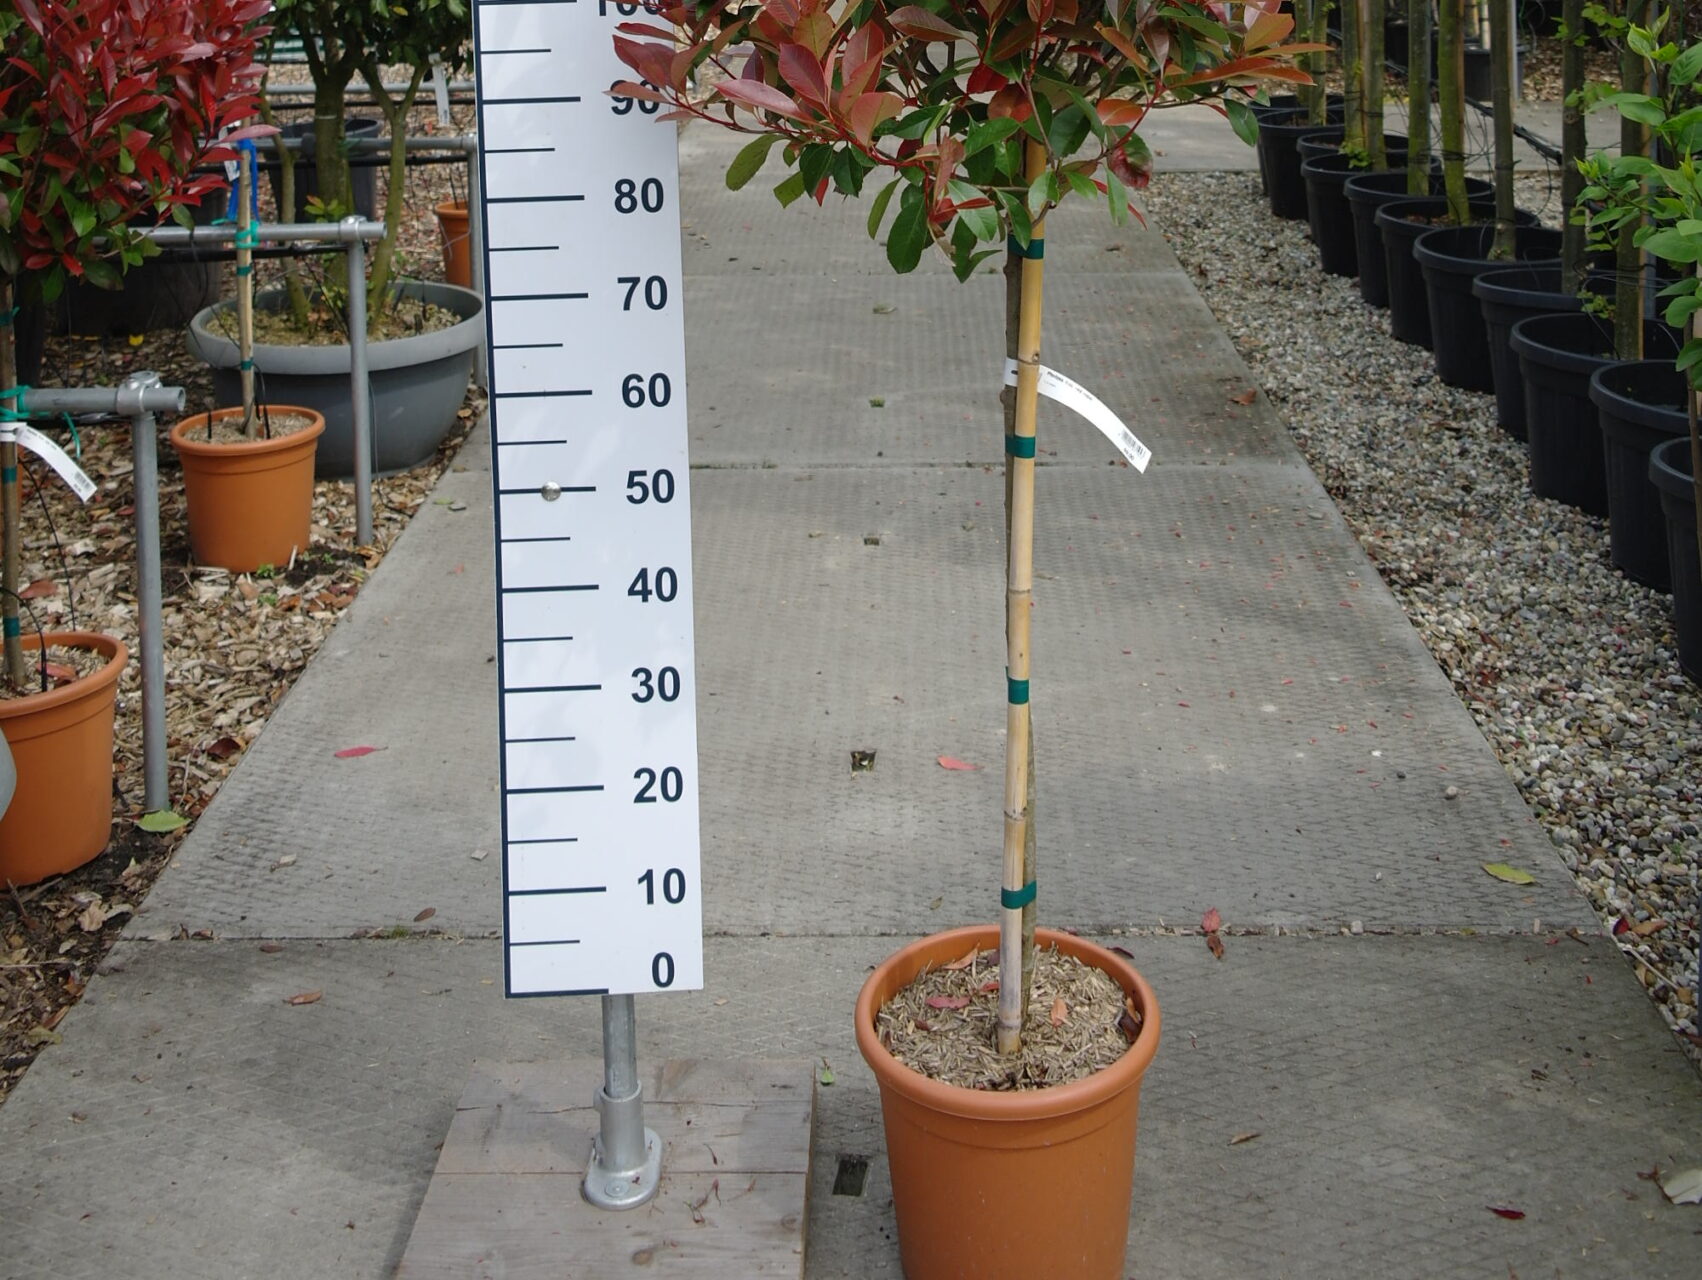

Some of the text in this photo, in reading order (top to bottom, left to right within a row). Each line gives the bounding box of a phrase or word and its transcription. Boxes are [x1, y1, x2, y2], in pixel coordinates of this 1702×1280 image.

[614, 177, 665, 215] 80
[617, 275, 668, 312] 70
[621, 372, 672, 409] 60
[625, 468, 675, 505] 50
[627, 566, 678, 603] 40
[631, 666, 681, 704] 30
[633, 766, 683, 804] 20
[637, 867, 686, 905] 10
[651, 951, 675, 988] 0
